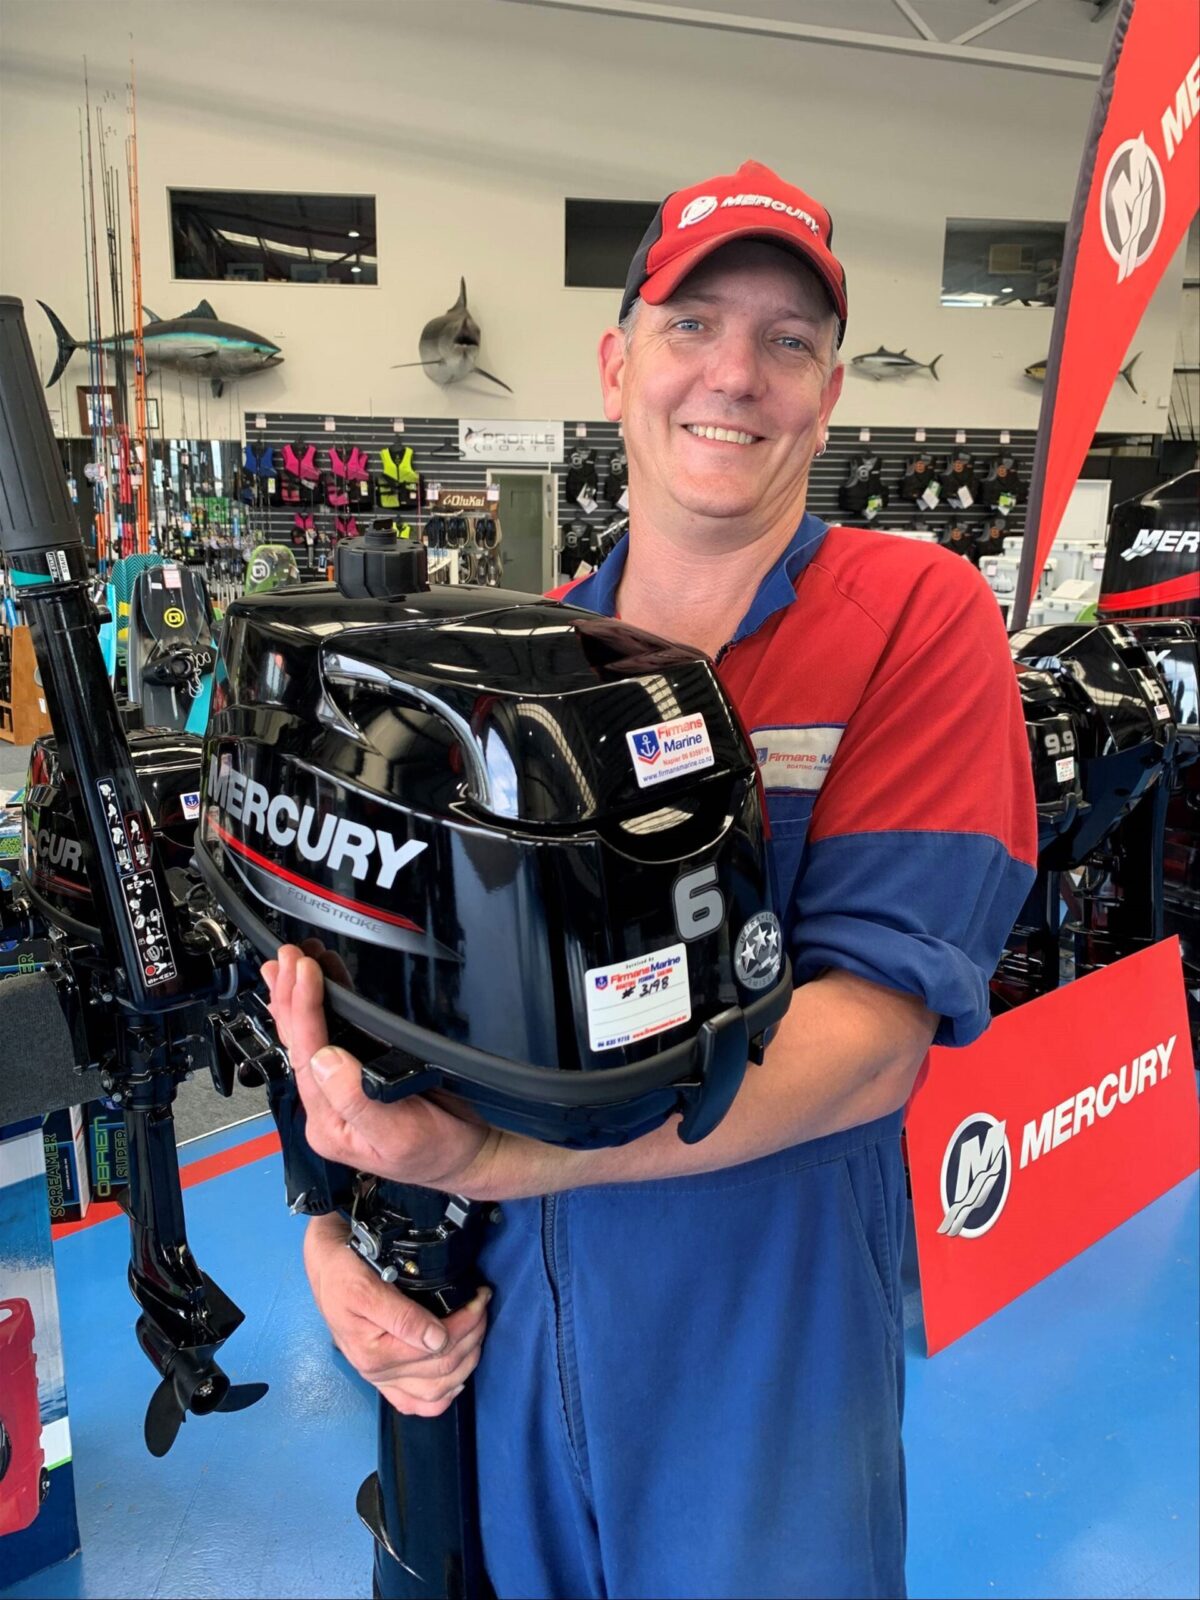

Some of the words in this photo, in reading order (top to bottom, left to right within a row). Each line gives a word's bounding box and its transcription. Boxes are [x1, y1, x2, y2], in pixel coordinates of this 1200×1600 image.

[720, 193, 820, 234] MERCURY
[482, 432, 556, 445] PROFILE
[482, 445, 556, 453] BOATS
[658, 718, 703, 740] Firmans
[663, 733, 703, 754] Marine
[1044, 730, 1076, 757] 9.9
[767, 752, 818, 764] Firmans
[207, 752, 429, 890] MERCURY
[37, 828, 88, 875] CUR
[286, 885, 384, 934] FOURSTROKE
[671, 861, 726, 943] 6
[1019, 1034, 1177, 1170] MERCURY
[43, 1132, 66, 1219] SCREAMER
